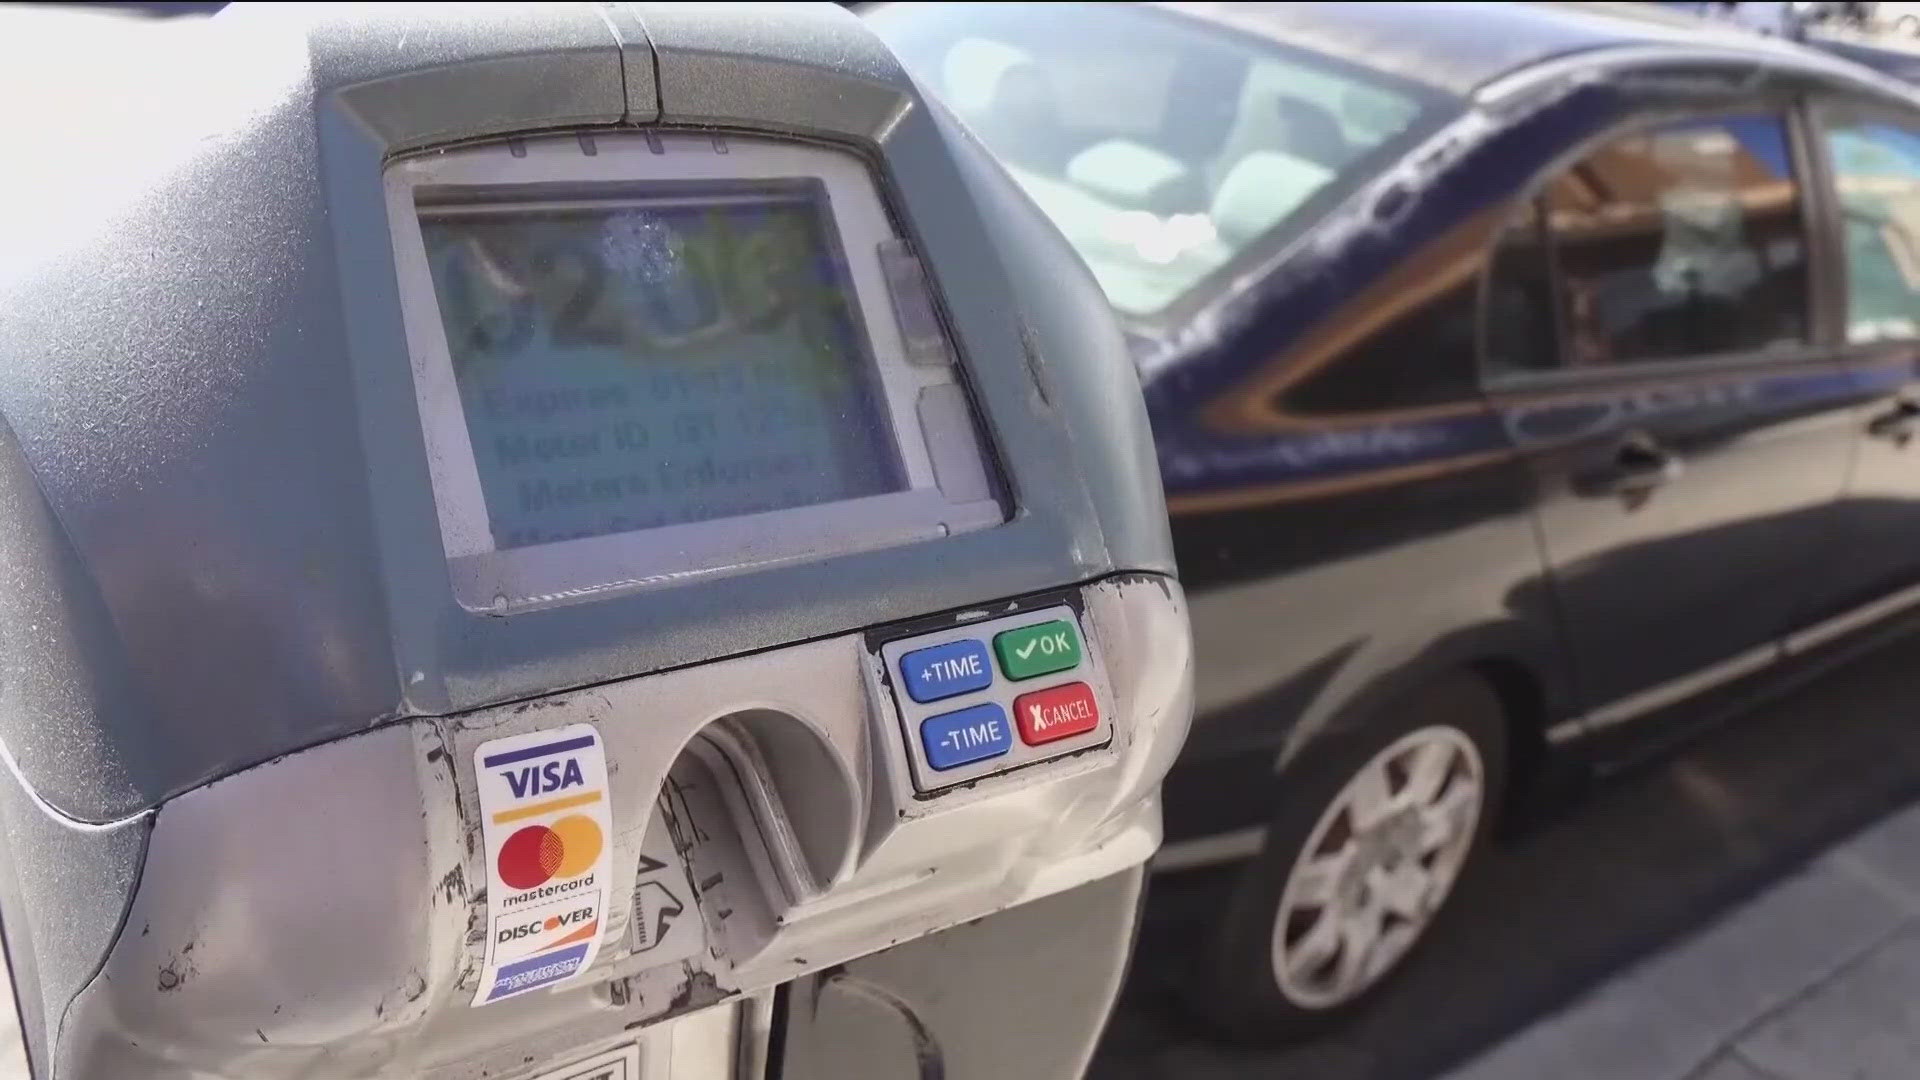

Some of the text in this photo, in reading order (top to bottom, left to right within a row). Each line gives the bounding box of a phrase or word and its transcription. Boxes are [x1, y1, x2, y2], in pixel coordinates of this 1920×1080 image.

[482, 382, 630, 421] Expires
[494, 430, 600, 468] Meter
[613, 420, 650, 452] ID
[517, 472, 649, 513] Meters
[1040, 631, 1072, 656] OK
[500, 757, 585, 799] VISA
[502, 873, 595, 908] mastercard
[498, 906, 594, 944] DISCOVER
